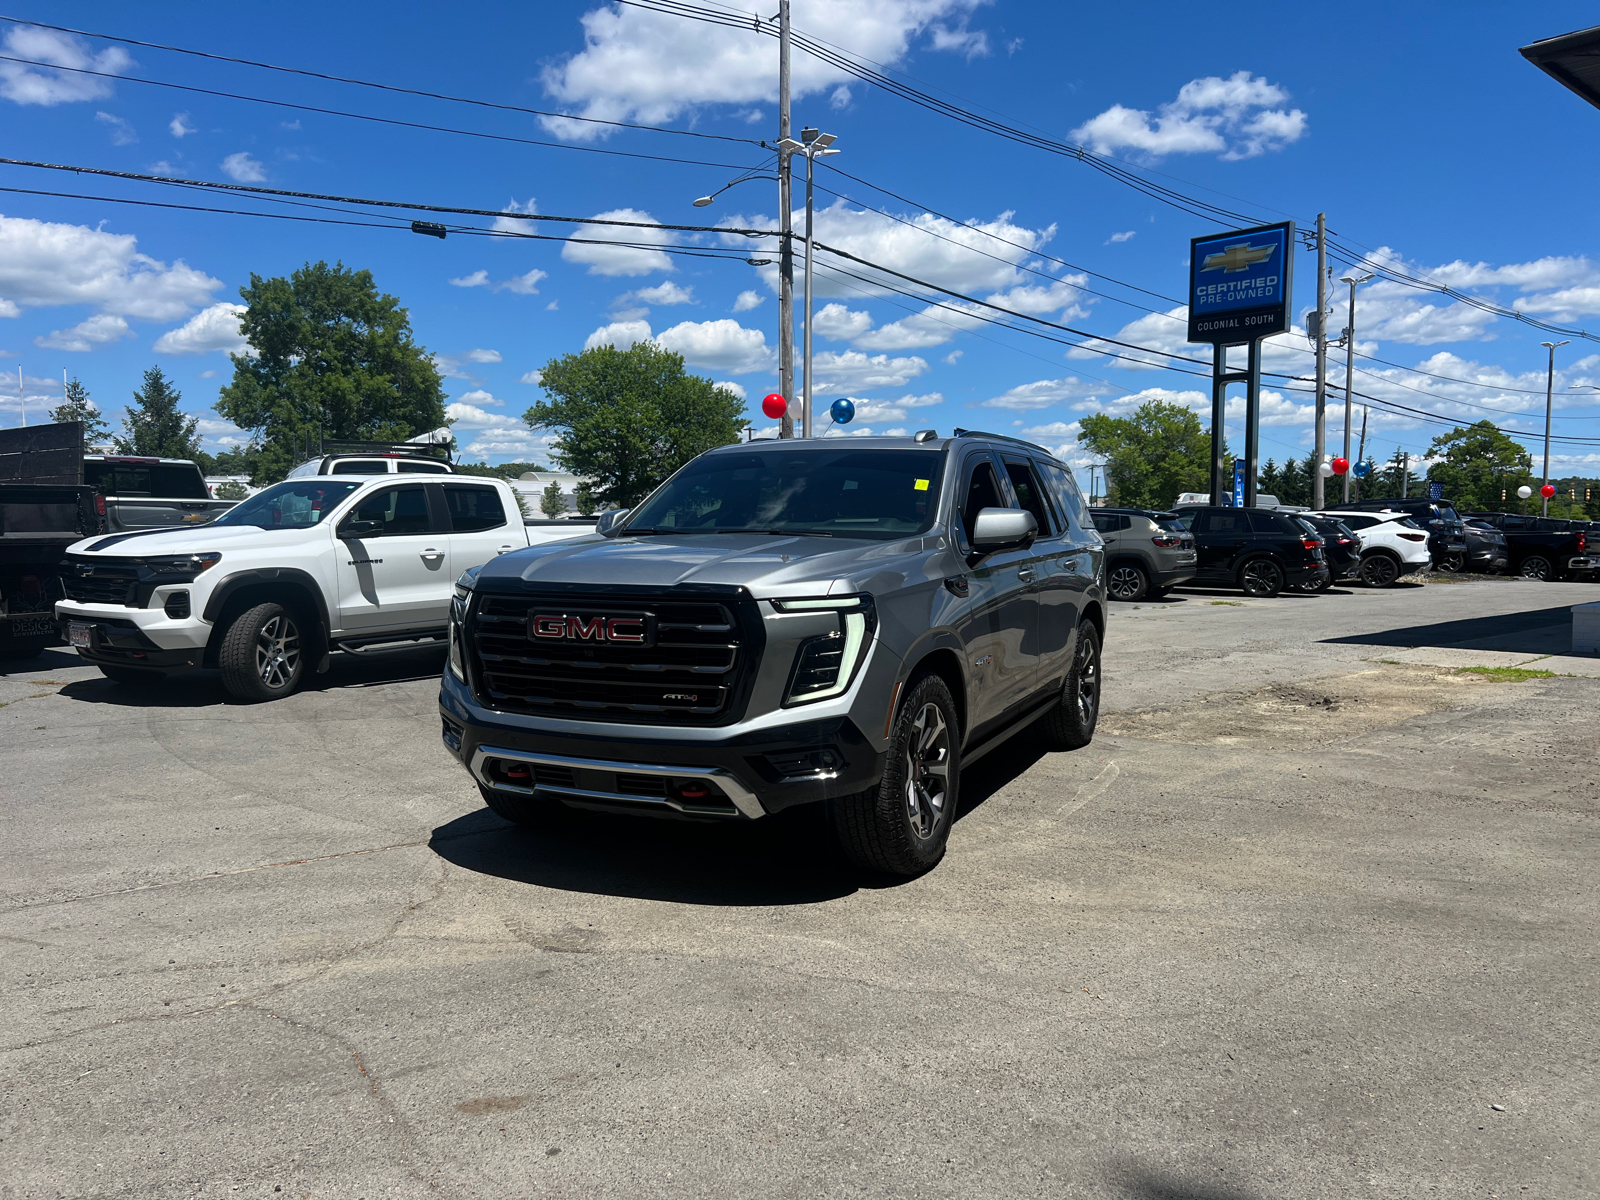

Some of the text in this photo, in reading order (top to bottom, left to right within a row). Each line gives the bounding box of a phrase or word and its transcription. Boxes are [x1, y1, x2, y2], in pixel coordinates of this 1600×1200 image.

[1197, 276, 1277, 295] CERTIFIED
[1201, 287, 1272, 304] PRE-OWNED
[1198, 315, 1273, 331] COLONIAL SOUTH
[13, 629, 55, 637] CONSTRUCTIO
[533, 614, 644, 642] GMC
[662, 693, 698, 702] AT4
